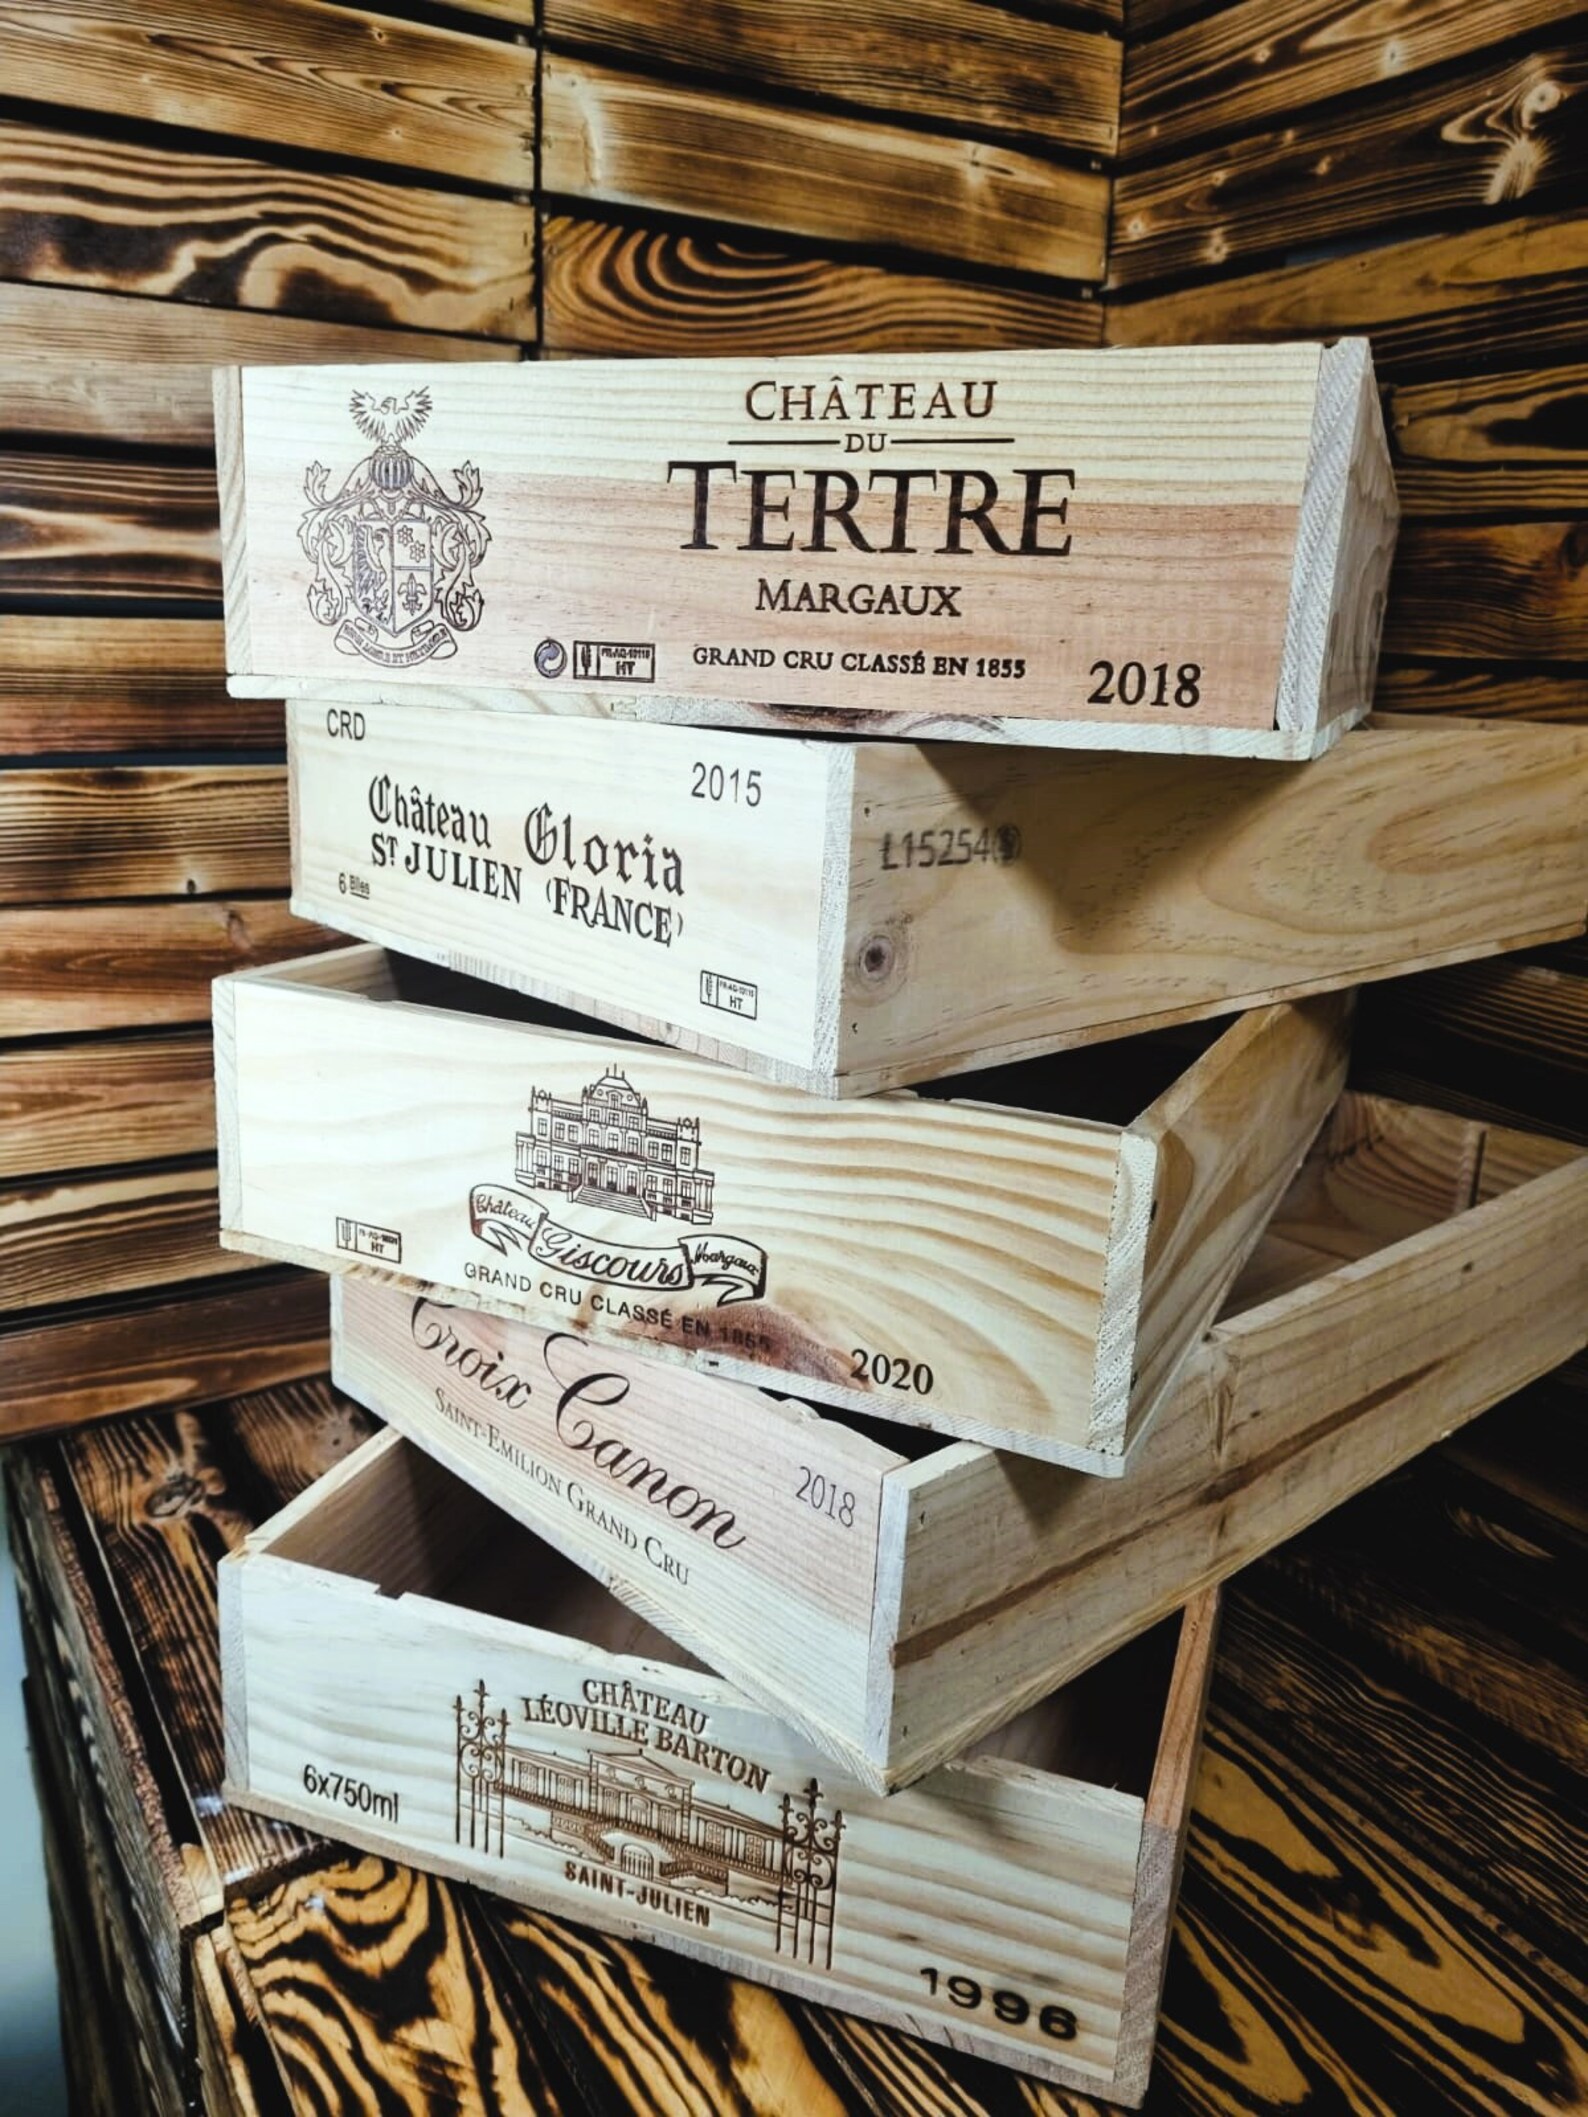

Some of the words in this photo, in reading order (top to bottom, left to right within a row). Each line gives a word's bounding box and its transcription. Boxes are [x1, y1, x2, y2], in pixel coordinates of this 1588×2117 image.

[745, 376, 999, 421] CHÂTEAU
[844, 433, 888, 454] DU
[667, 460, 1076, 556] TERTRE
[755, 578, 962, 618] MARGAUX
[616, 660, 636, 676] HT
[693, 646, 776, 669] GRAND
[783, 651, 834, 672] CRU
[840, 649, 927, 676] CLASSÉ
[933, 656, 968, 678] EN
[975, 657, 1027, 680] 1855
[1087, 659, 1203, 709] 2018
[326, 708, 367, 742] CRD
[691, 761, 763, 808] 2015
[368, 773, 493, 849] Château
[524, 802, 686, 897] Gloria
[338, 871, 347, 895] 6
[405, 840, 522, 904] JULIEN
[546, 876, 685, 949] (FRANCE)
[729, 994, 744, 1011] HT
[475, 1193, 537, 1231] Château
[536, 1225, 685, 1286] Giscours
[464, 1261, 533, 1293] GRAND
[539, 1281, 582, 1307] CRU
[590, 1294, 673, 1331] CLASSÉ
[681, 1314, 710, 1338] EN
[850, 1348, 935, 1396] 2020
[543, 1332, 748, 1552] Canon
[795, 1465, 856, 1529] 2018
[566, 1481, 638, 1551] GRAND
[644, 1535, 691, 1587] CRU
[582, 1678, 710, 1736] CHÂTEAU
[520, 1693, 648, 1747] LÉOVILLE
[655, 1727, 772, 1794] BARTON
[564, 1860, 711, 1929] SAINT-JULIEN
[920, 1967, 1079, 2042] 1996
